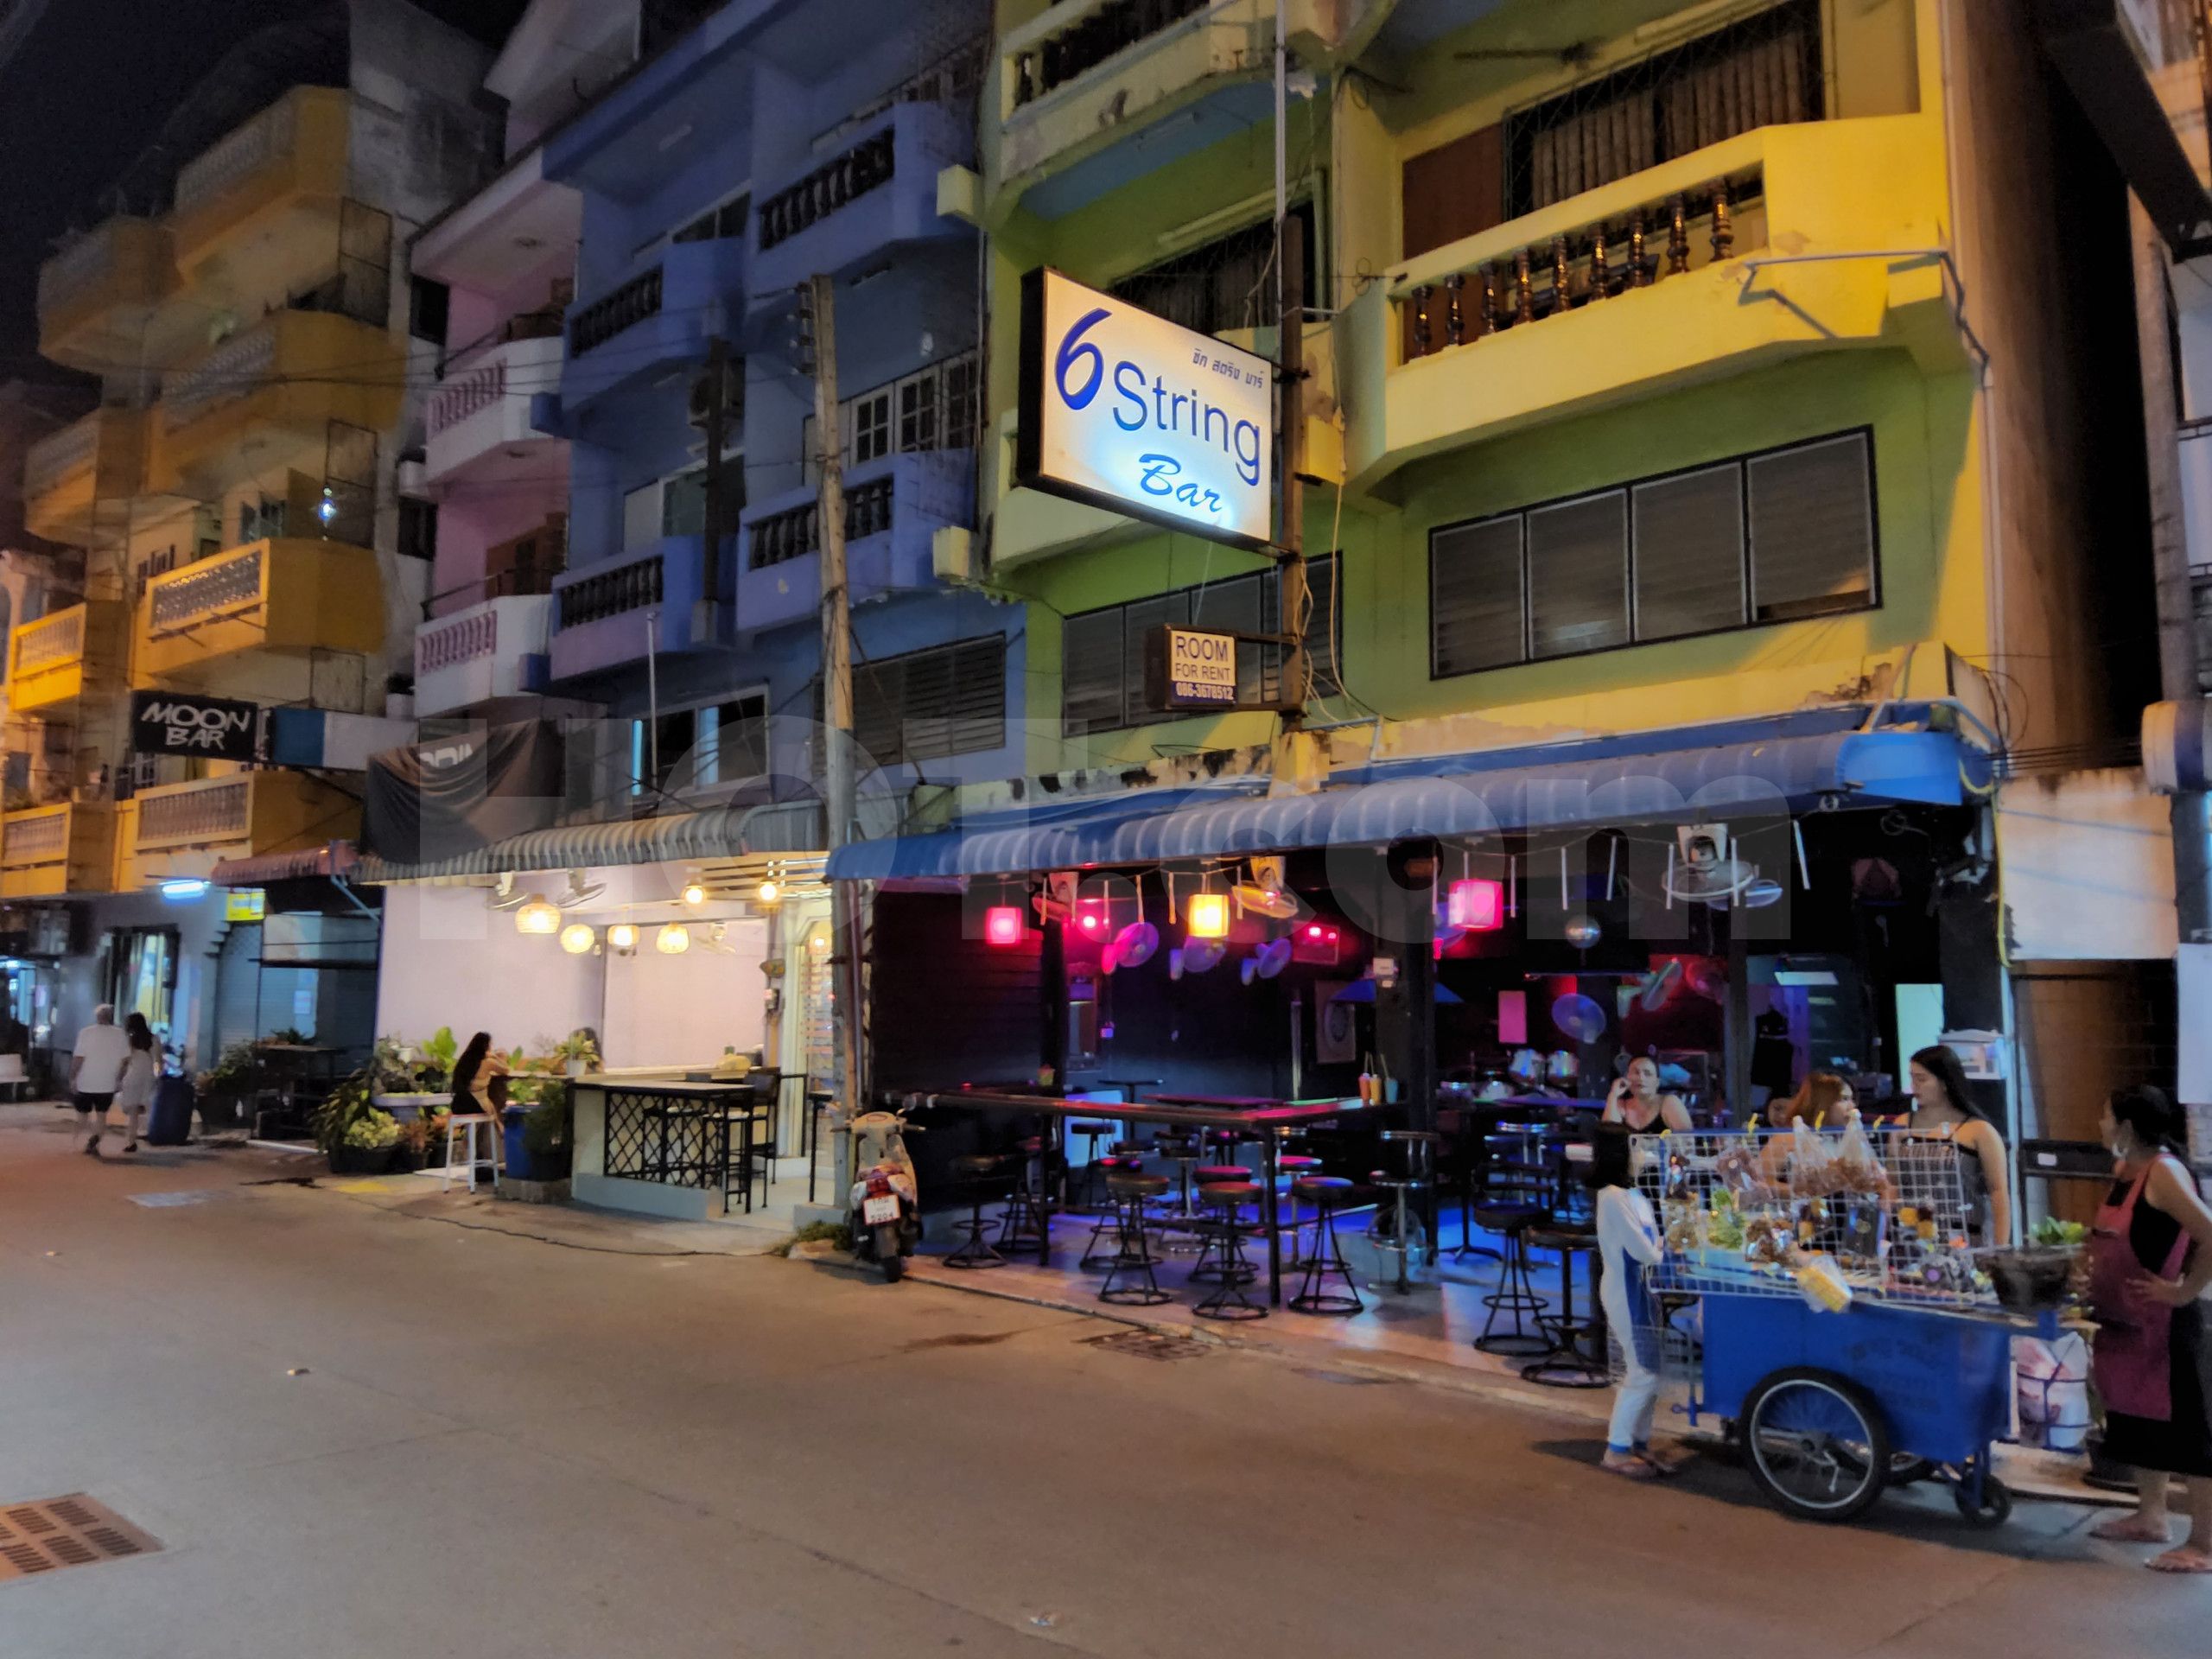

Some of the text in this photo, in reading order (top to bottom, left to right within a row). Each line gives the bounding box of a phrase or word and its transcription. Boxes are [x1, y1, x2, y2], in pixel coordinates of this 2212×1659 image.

[1054, 308, 1260, 486] 6 String
[1139, 454, 1223, 512] Bar
[1176, 636, 1228, 661] ROOM
[1175, 663, 1231, 681] FOR RENT
[141, 702, 251, 732] MOON
[165, 726, 225, 751] BAR
